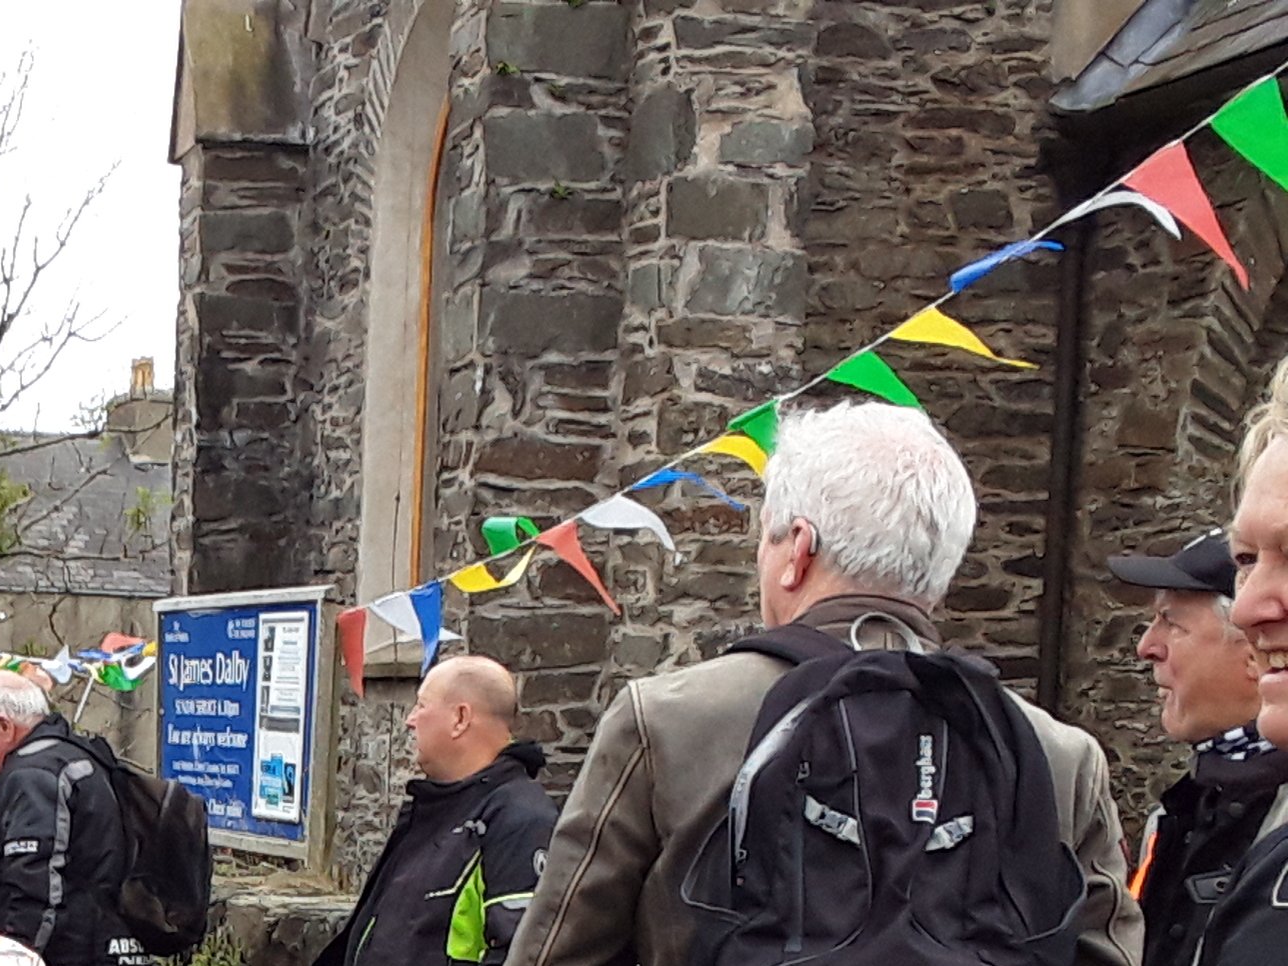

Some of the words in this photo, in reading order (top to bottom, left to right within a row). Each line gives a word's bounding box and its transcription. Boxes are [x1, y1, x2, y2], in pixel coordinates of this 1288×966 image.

[179, 655, 213, 691] James
[216, 650, 251, 691] Dalby
[915, 735, 936, 800] berghaus
